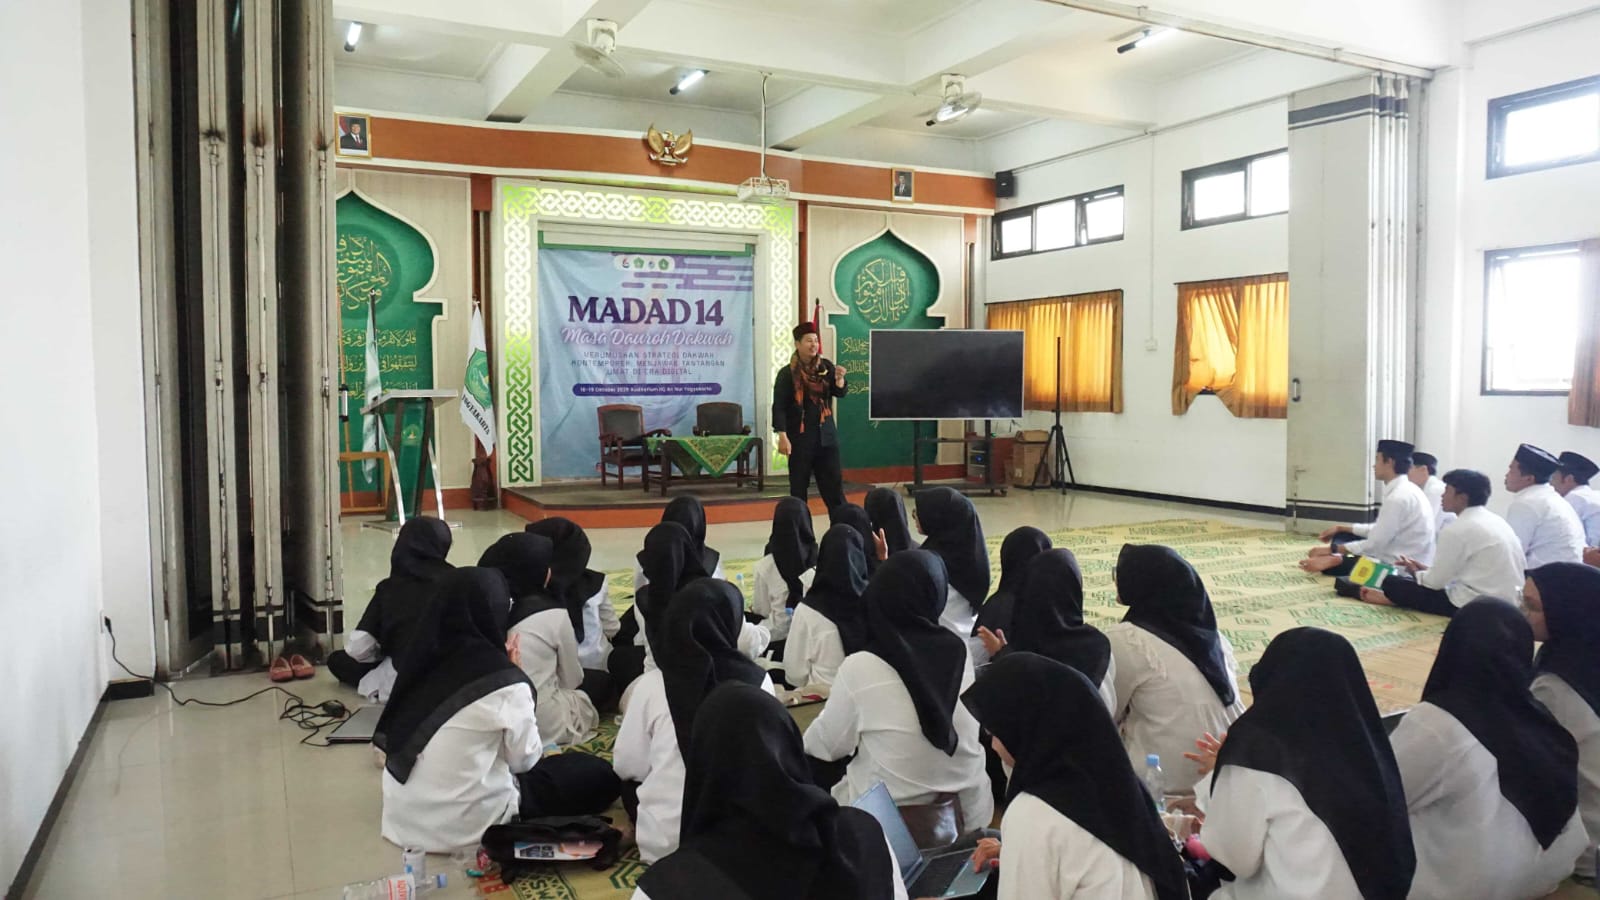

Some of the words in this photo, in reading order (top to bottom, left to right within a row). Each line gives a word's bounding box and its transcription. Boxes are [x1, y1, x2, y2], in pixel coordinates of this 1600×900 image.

[568, 295, 692, 325] MADAD
[695, 299, 724, 326] 14
[562, 327, 607, 346] Masa
[611, 327, 671, 346] Dauroh
[672, 328, 733, 346] Dakwah
[682, 351, 714, 359] DAKWAH
[682, 359, 725, 367] TANTANGAN
[662, 367, 693, 375] DIGITAL
[461, 394, 490, 435] YOGYAKARTA
